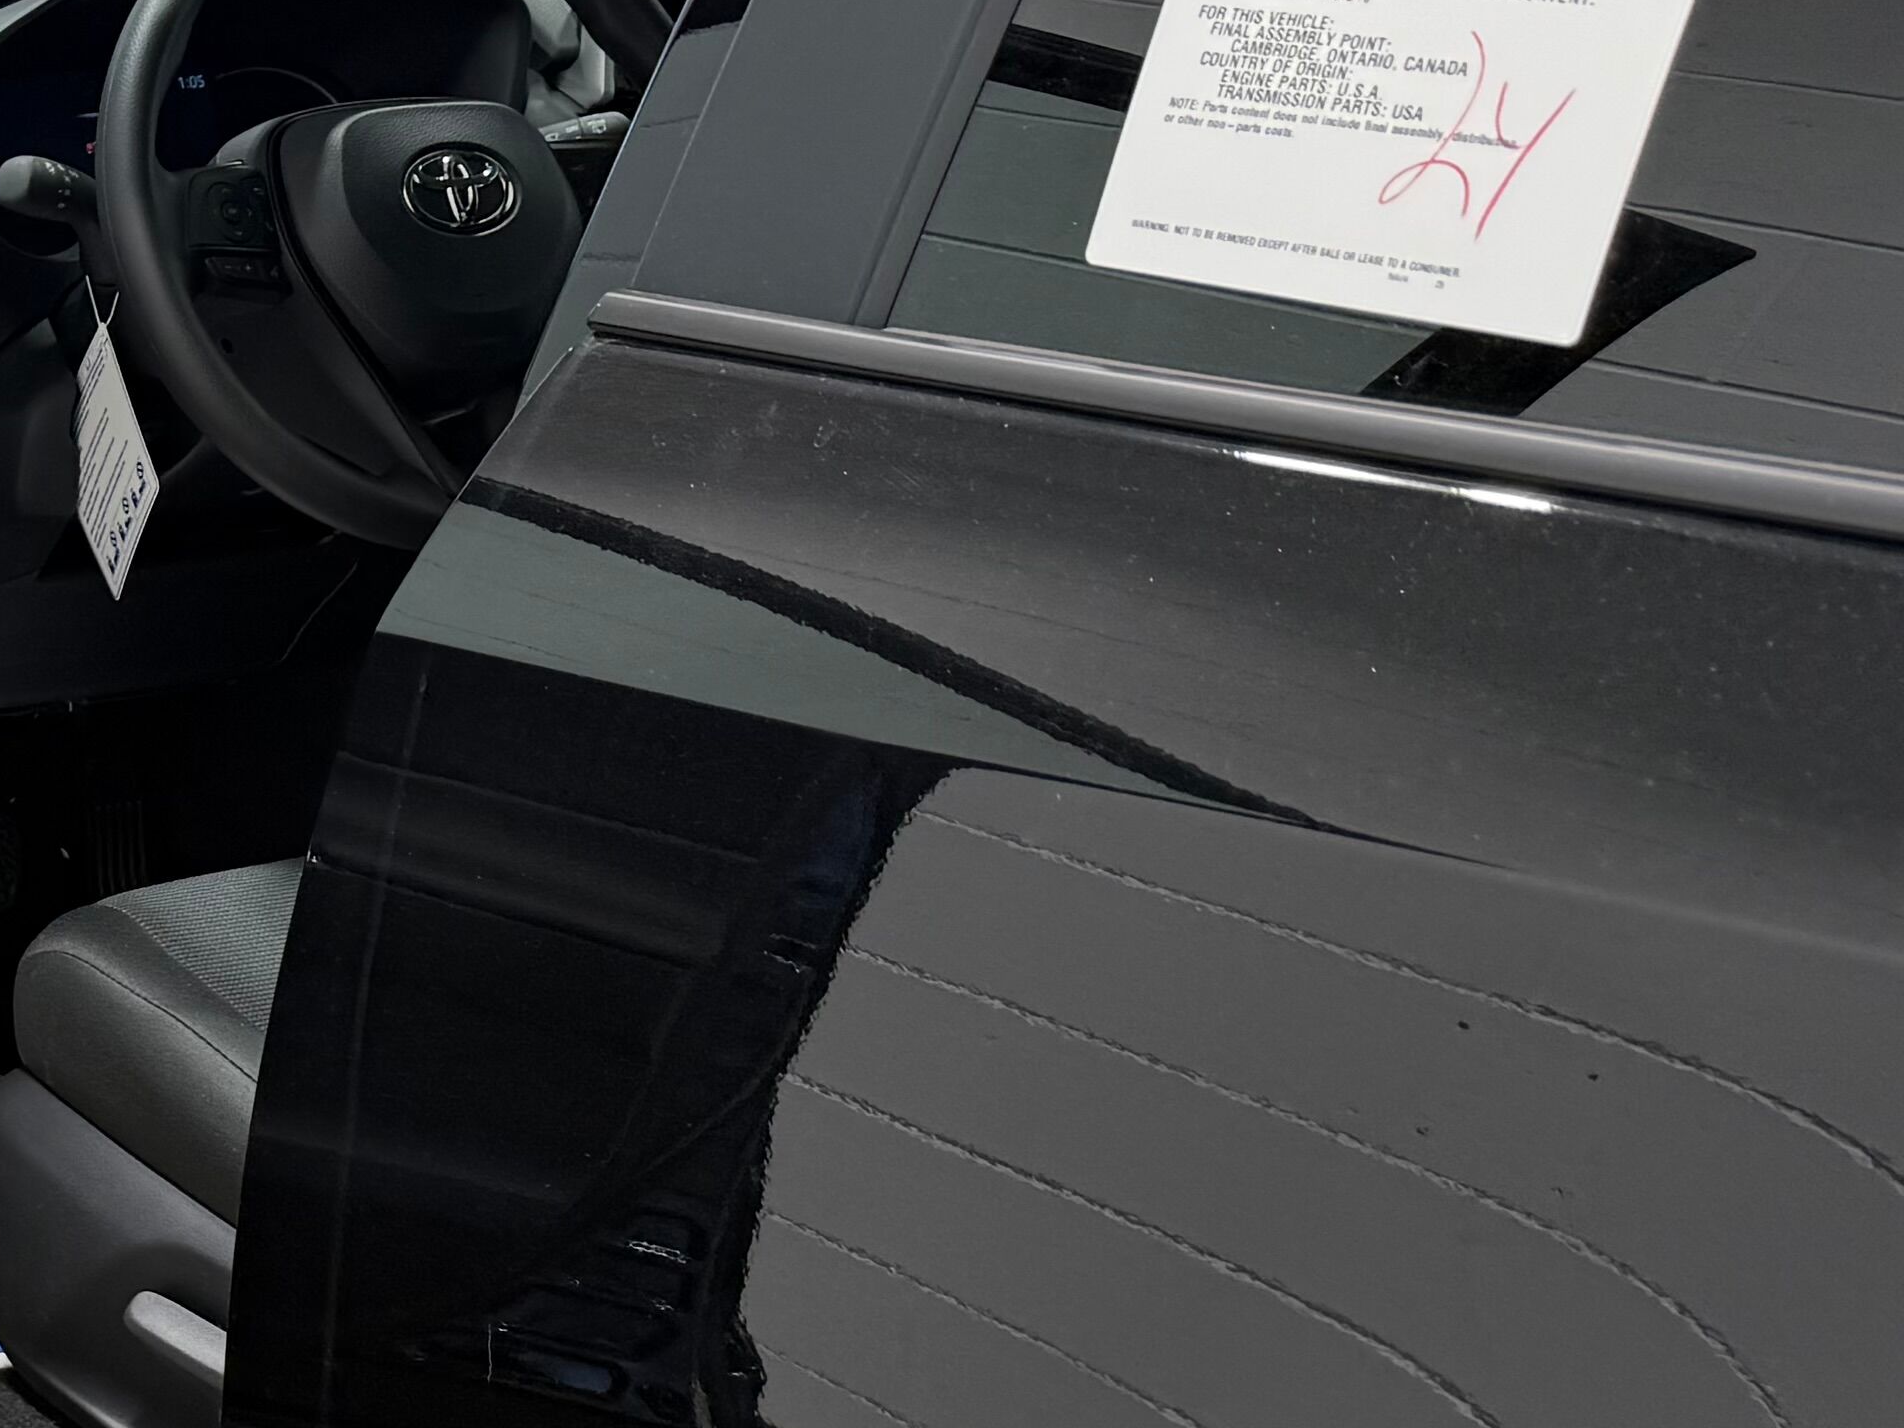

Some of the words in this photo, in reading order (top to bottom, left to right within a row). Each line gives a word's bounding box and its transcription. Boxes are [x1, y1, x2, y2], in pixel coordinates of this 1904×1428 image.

[1199, 4, 1227, 20] FOR
[1232, 8, 1263, 25] THIS
[1269, 12, 1335, 30] VEHICLE:
[1210, 21, 1251, 38] FINAL
[1255, 26, 1336, 46] ASSEMBLY
[1341, 34, 1392, 52] POINT:
[1200, 51, 1269, 70] COUNTRY
[1273, 58, 1292, 73] OF
[1295, 61, 1354, 80] ORIGIN:
[1403, 57, 1468, 76] CANADA
[1221, 69, 1272, 88] ENGINE
[1278, 75, 1333, 94] PARTS:
[1168, 97, 1199, 111] NOTE:
[1202, 101, 1228, 114] Parts
[1231, 106, 1271, 120] content
[1273, 110, 1297, 122] does
[1301, 114, 1319, 124] not
[1321, 115, 1361, 130] include
[1217, 84, 1327, 109] TRANSMISSION
[1330, 98, 1388, 117] PARTS:
[1392, 104, 1423, 121] USA
[1164, 113, 1175, 123] or
[1177, 115, 1204, 126] other
[1174, 225, 1190, 236] NOT
[1192, 227, 1202, 238] TO
[1204, 230, 1215, 240] BE
[1217, 231, 1256, 246] REMOVED
[1257, 238, 1289, 251] EXCEPT
[1291, 243, 1317, 255] AFTER
[1320, 247, 1340, 260] SALE
[1343, 251, 1356, 261] OR
[1358, 254, 1384, 266] LEASE
[1388, 257, 1399, 268] TO
[1400, 260, 1406, 269] A
